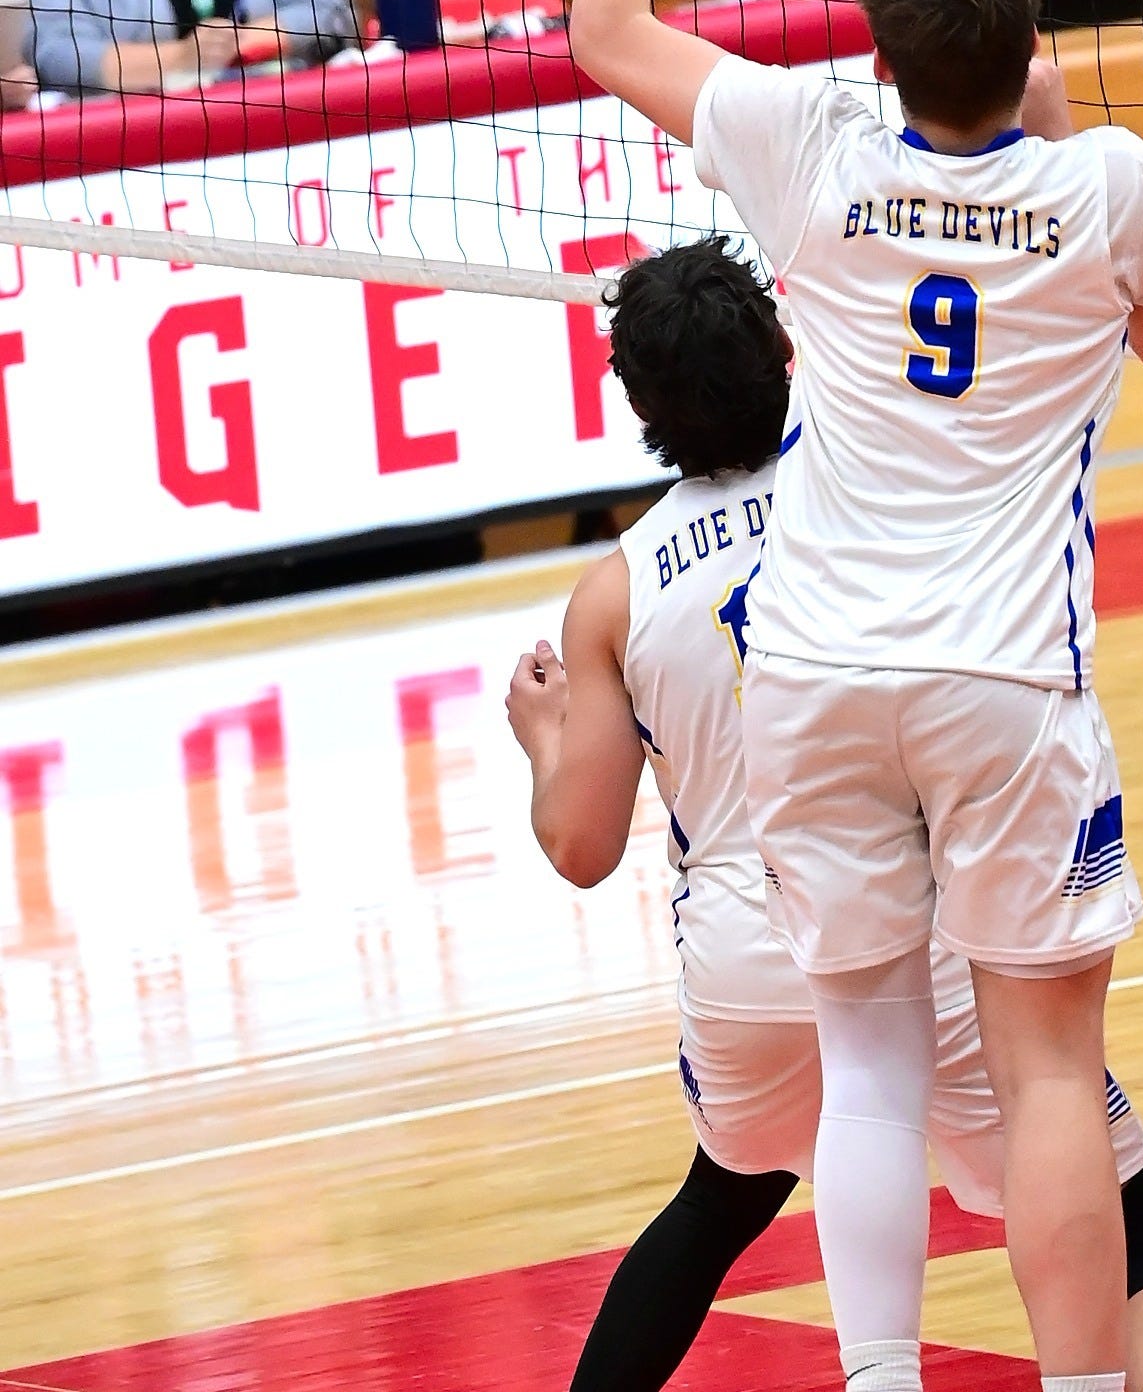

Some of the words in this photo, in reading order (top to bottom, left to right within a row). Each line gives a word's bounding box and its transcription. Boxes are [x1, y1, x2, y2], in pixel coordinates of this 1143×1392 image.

[292, 167, 396, 247] OF
[499, 126, 683, 217] THE
[843, 198, 927, 239] BLUE
[941, 200, 1061, 259] DEVILS
[901, 269, 985, 403] 9
[655, 506, 734, 591] BLUE
